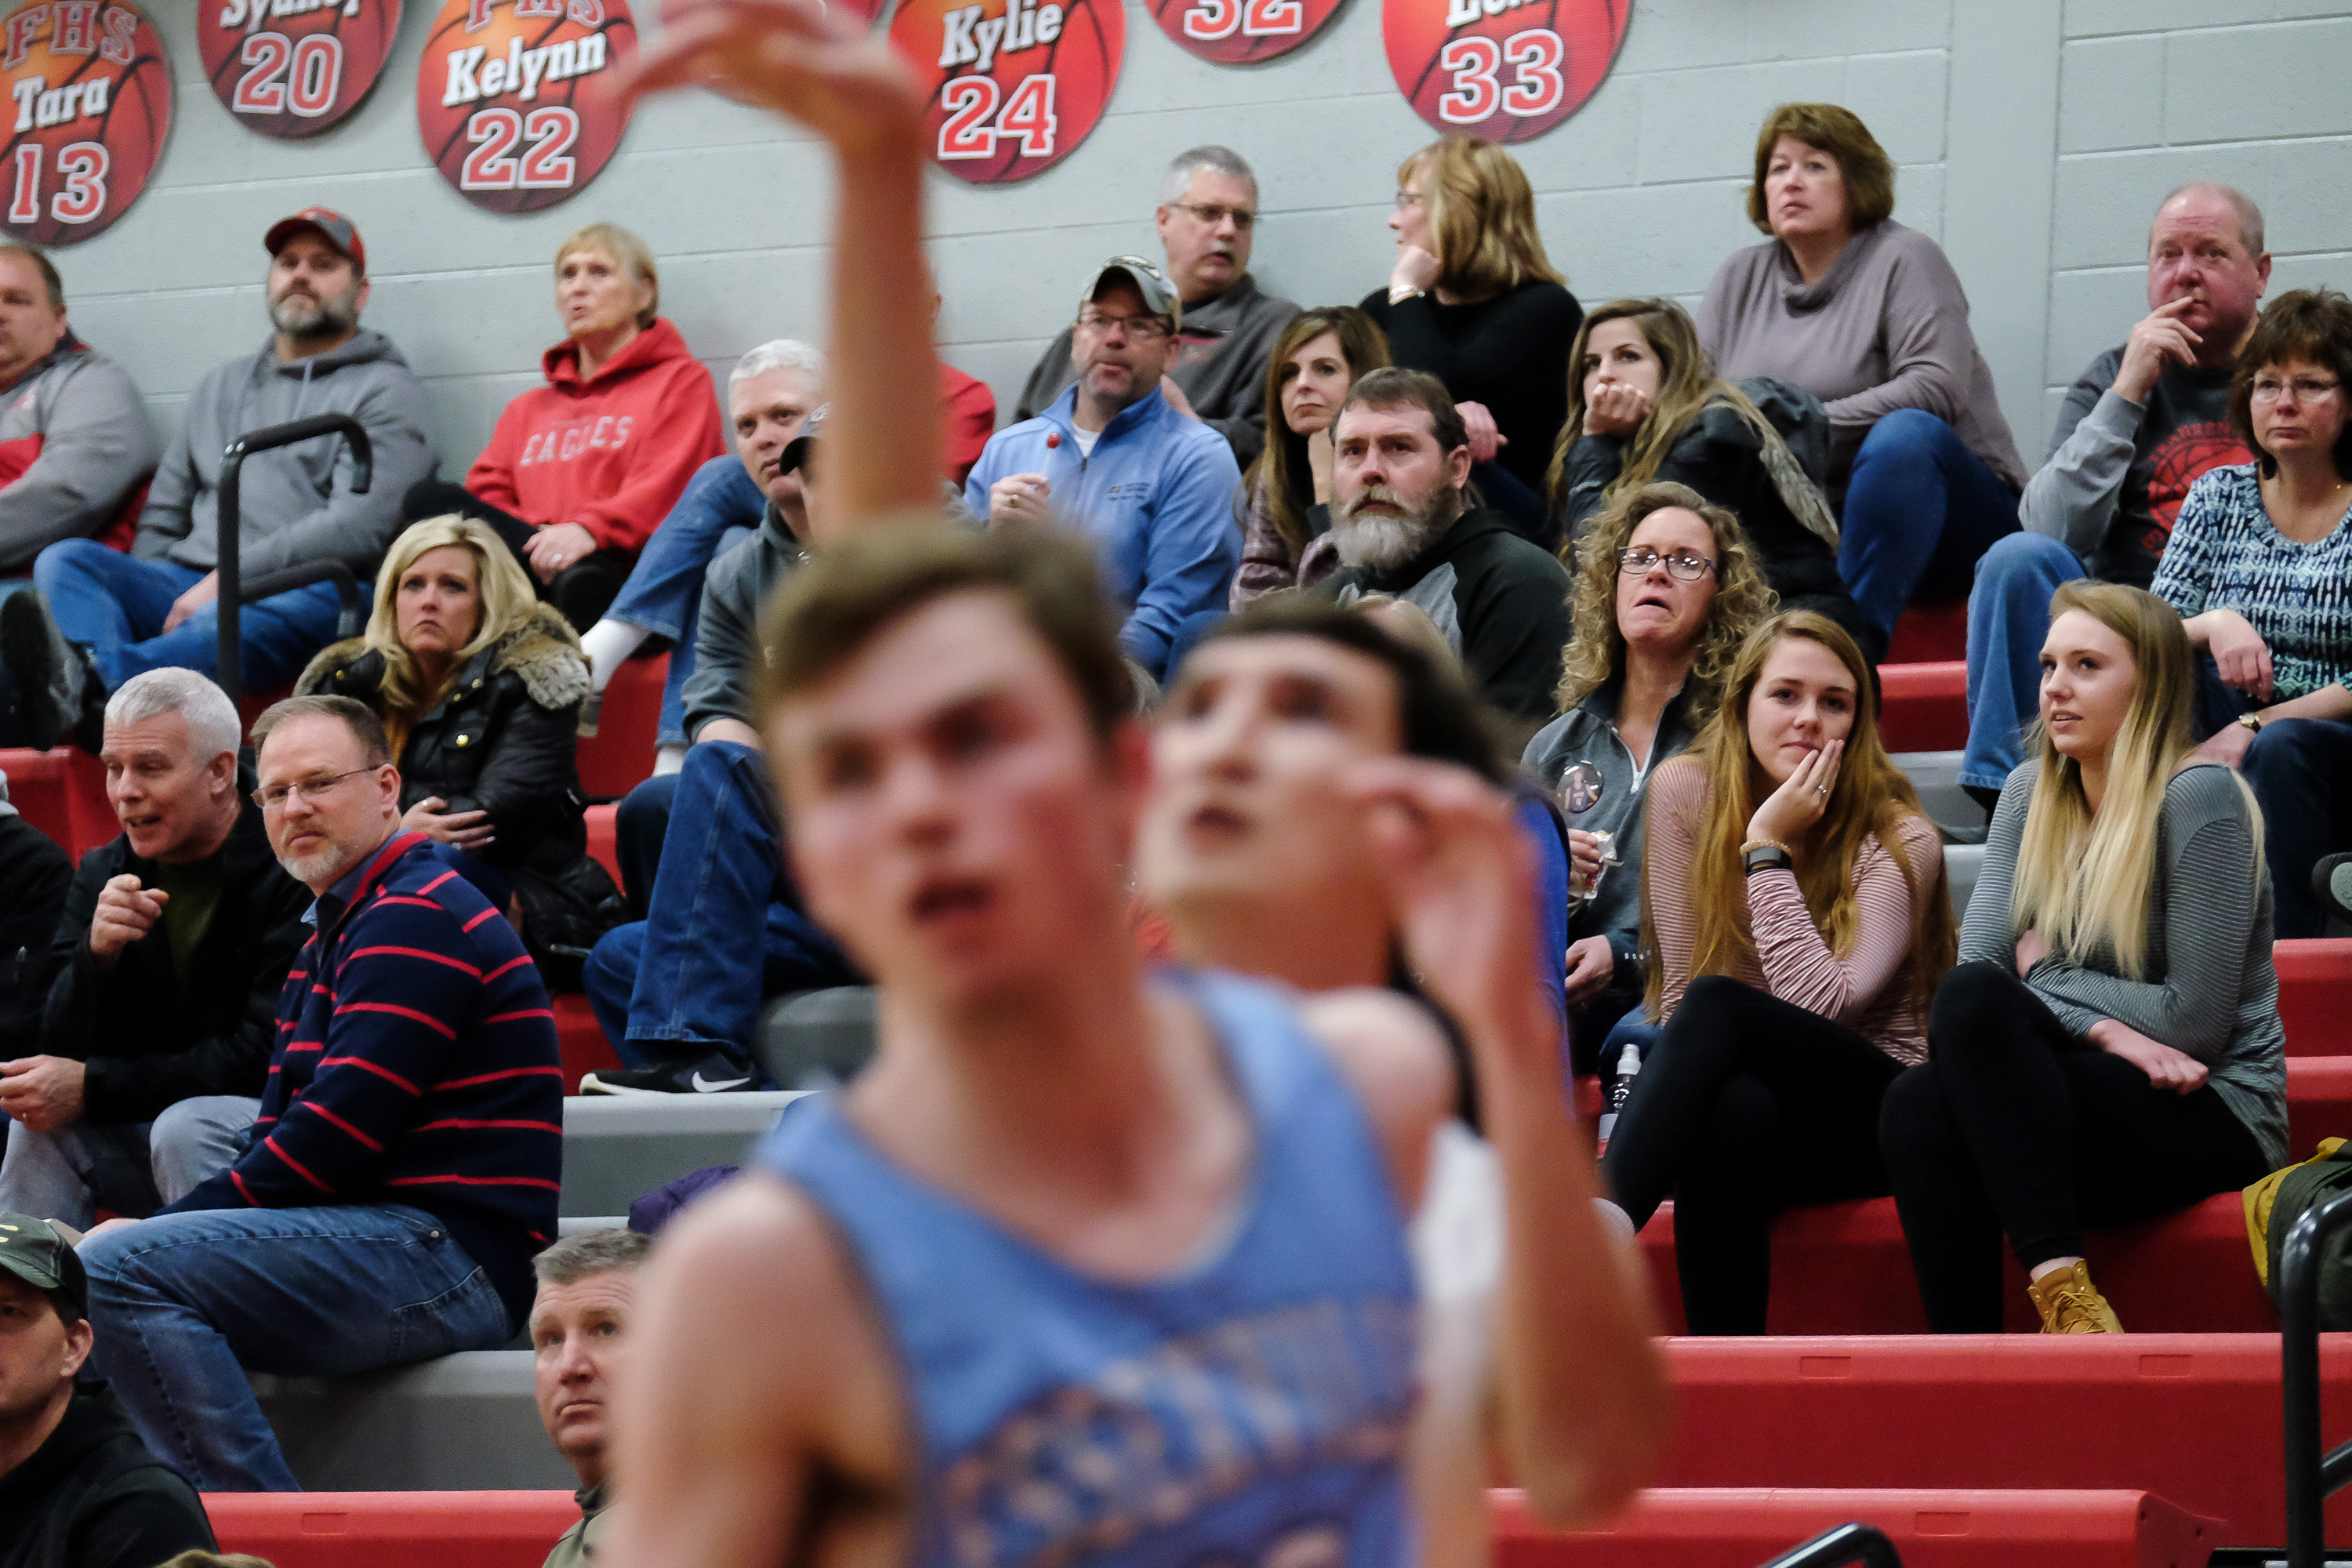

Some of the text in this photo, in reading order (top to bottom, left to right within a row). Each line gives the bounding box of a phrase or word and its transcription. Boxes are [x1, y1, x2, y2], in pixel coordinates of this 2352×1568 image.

[2, 2, 138, 70] FHS
[232, 31, 343, 118] 20
[442, 32, 607, 106] Kelynn
[938, 0, 1063, 72] Kylie
[1439, 28, 1565, 124] 33
[13, 74, 111, 132] Tara
[937, 74, 1057, 160] 24
[9, 141, 110, 224] 13
[460, 106, 580, 190] 22
